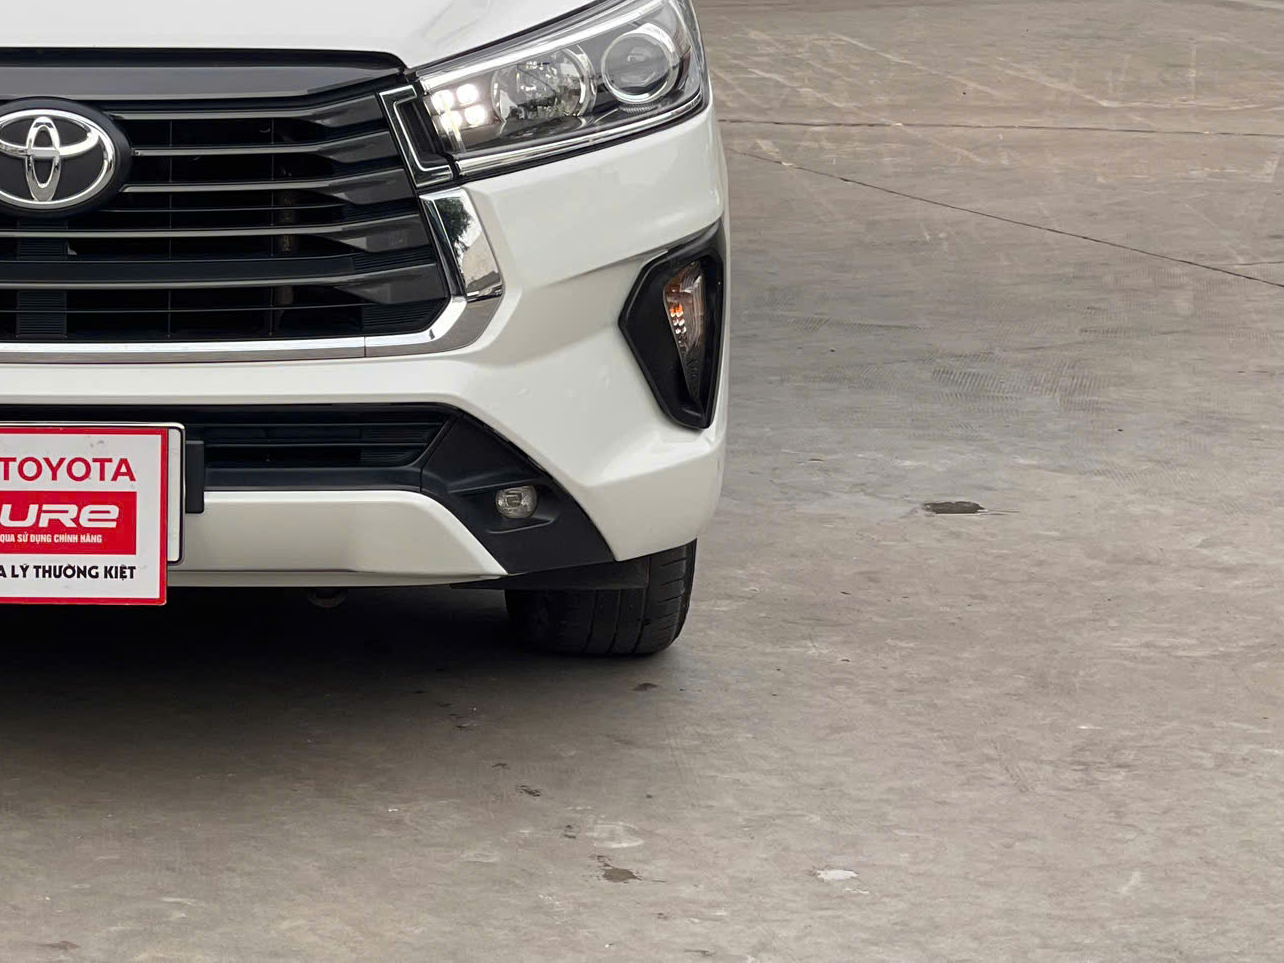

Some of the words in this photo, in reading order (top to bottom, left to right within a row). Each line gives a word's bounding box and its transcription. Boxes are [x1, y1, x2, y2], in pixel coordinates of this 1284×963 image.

[0, 533, 15, 543] QUA
[11, 563, 30, 579] LÝ
[103, 564, 137, 582] KIỆT
